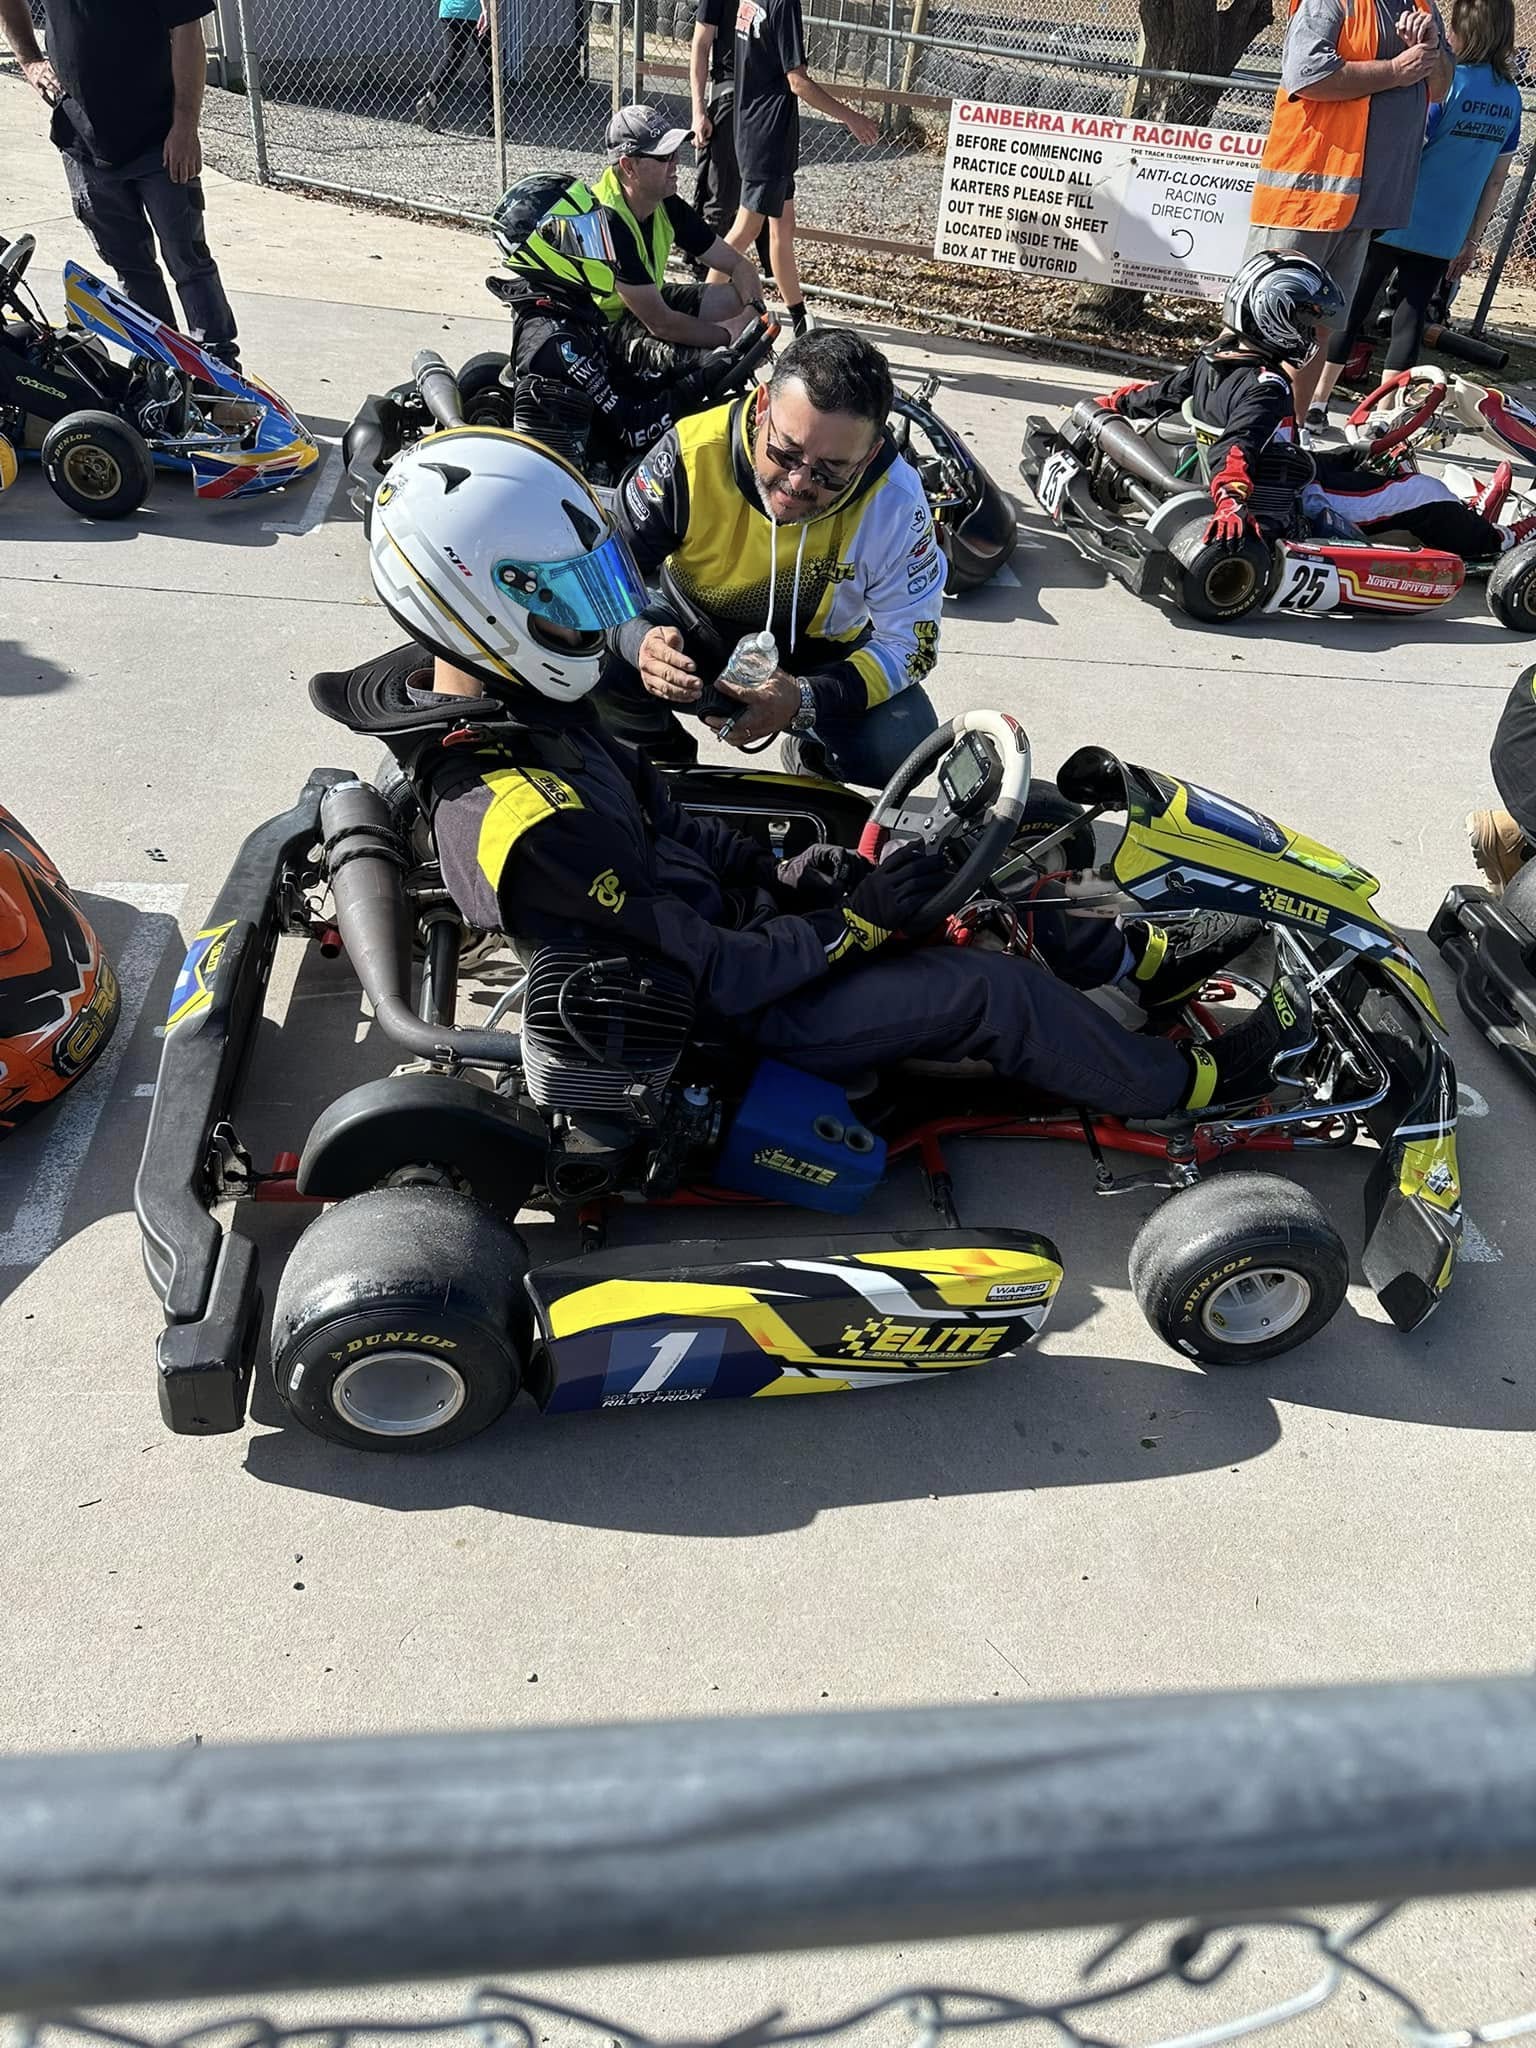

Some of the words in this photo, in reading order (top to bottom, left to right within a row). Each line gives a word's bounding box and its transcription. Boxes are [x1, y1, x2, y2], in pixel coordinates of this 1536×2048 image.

[959, 105, 1065, 133] CANBERRA
[1071, 118, 1127, 139] KART
[1133, 127, 1212, 148] RACING
[1219, 136, 1267, 156] CLU
[1456, 120, 1506, 136] KARTING
[956, 134, 1006, 152] BEFORE
[1011, 140, 1103, 164] COMMENCING
[1174, 154, 1211, 163] CURRENTLY
[953, 156, 1016, 177] PRACTICE
[1020, 164, 1064, 182] COULD
[1068, 170, 1092, 186] ALL
[1137, 168, 1255, 192] ANTI-CLOCKWISE
[950, 178, 1009, 198] KARTERS
[1013, 184, 1063, 205] PLEASE
[1067, 193, 1094, 209] FILL
[1165, 188, 1216, 205] RACING
[948, 200, 973, 215] OUT
[977, 202, 1002, 219] THE
[1007, 207, 1037, 225] SIGN
[1041, 213, 1059, 228] ON
[1065, 216, 1108, 233] SHEET
[1151, 203, 1224, 224] DIRECTION
[945, 221, 1002, 240] LOCATED
[1005, 228, 1048, 247] INSIDE
[1053, 235, 1079, 252] THE
[942, 242, 967, 257] BOX
[971, 245, 987, 260] AT
[992, 249, 1016, 264] THE
[1019, 254, 1077, 273] OUTGRID
[1142, 266, 1171, 275] OFFENCE
[1140, 283, 1167, 292] LICENSE
[1185, 290, 1211, 298] RESULT
[1163, 277, 1199, 285] DIRECTION
[54, 432, 91, 457] DUNLOP
[1278, 565, 1330, 608] 25
[1366, 574, 1399, 590] Nowra
[1400, 580, 1434, 597] Driving
[1272, 893, 1330, 926] ELITE
[768, 1153, 838, 1183] ELITE
[996, 1284, 1046, 1294] WARPED
[1183, 1256, 1253, 1312] DUNLOP
[347, 1332, 459, 1353] DUNLOP
[869, 1325, 1010, 1352] ELITE
[629, 1332, 698, 1393] 1
[602, 1397, 651, 1408] RILEY
[652, 1393, 702, 1403] PRIOR
